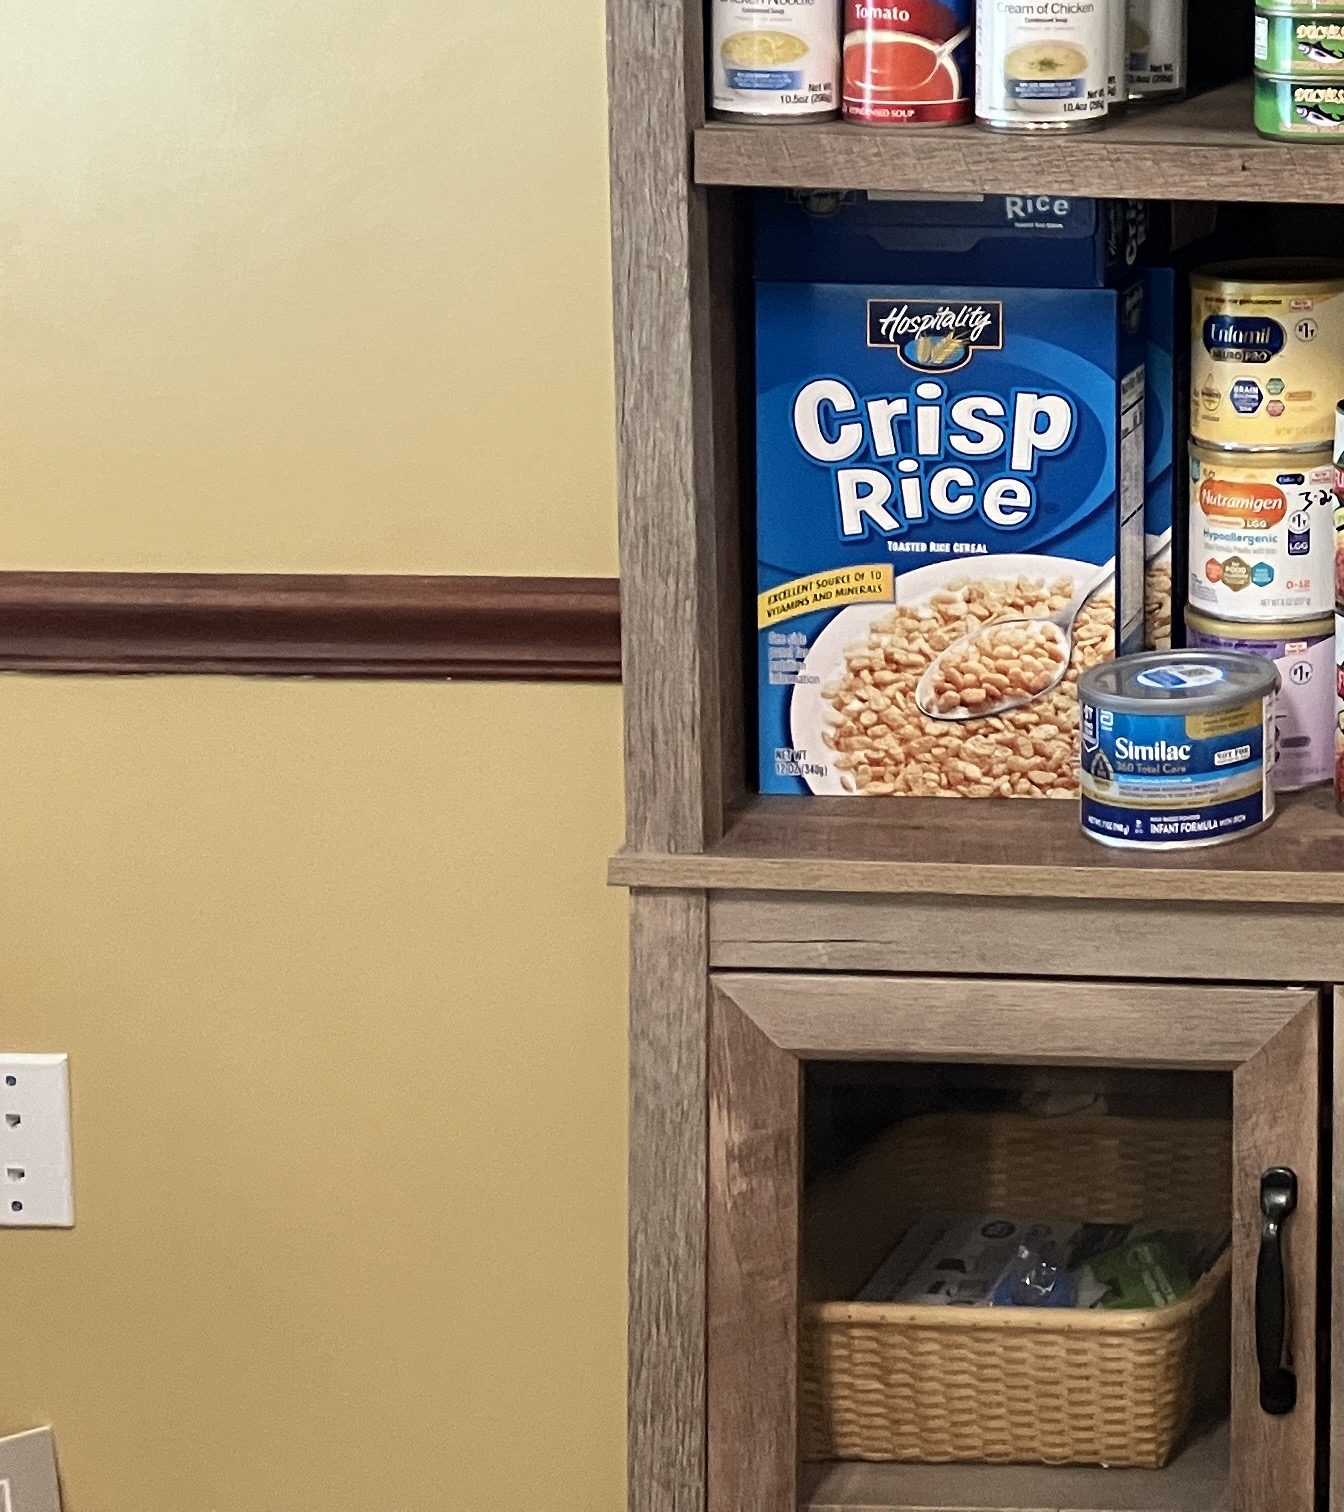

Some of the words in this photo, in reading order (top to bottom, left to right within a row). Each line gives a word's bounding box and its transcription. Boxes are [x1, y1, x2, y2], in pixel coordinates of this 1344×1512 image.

[855, 3, 910, 22] Tomato
[997, 2, 1034, 14] Cream
[1037, 2, 1049, 14] of
[1051, 2, 1094, 14] Chicken
[1005, 195, 1069, 220] Rice
[879, 304, 992, 343] Hospitality
[793, 379, 1074, 472] Crisp
[836, 459, 1033, 536] Rice
[1201, 487, 1283, 511] Nutramigen
[887, 540, 927, 554] TOASTED
[929, 541, 951, 554] RICE
[953, 542, 988, 554] CEREAL
[1202, 528, 1278, 544] Hypoallergenic
[767, 582, 813, 605] EXCELLENT
[816, 574, 850, 589] SOURCE
[871, 571, 882, 580] 10
[766, 596, 810, 618] VITAMINS
[812, 591, 832, 603] AND
[835, 584, 882, 598] MINERALS
[1114, 737, 1191, 761] Similac
[1150, 823, 1179, 834] INFANT
[1180, 820, 1219, 833] FORMULA
